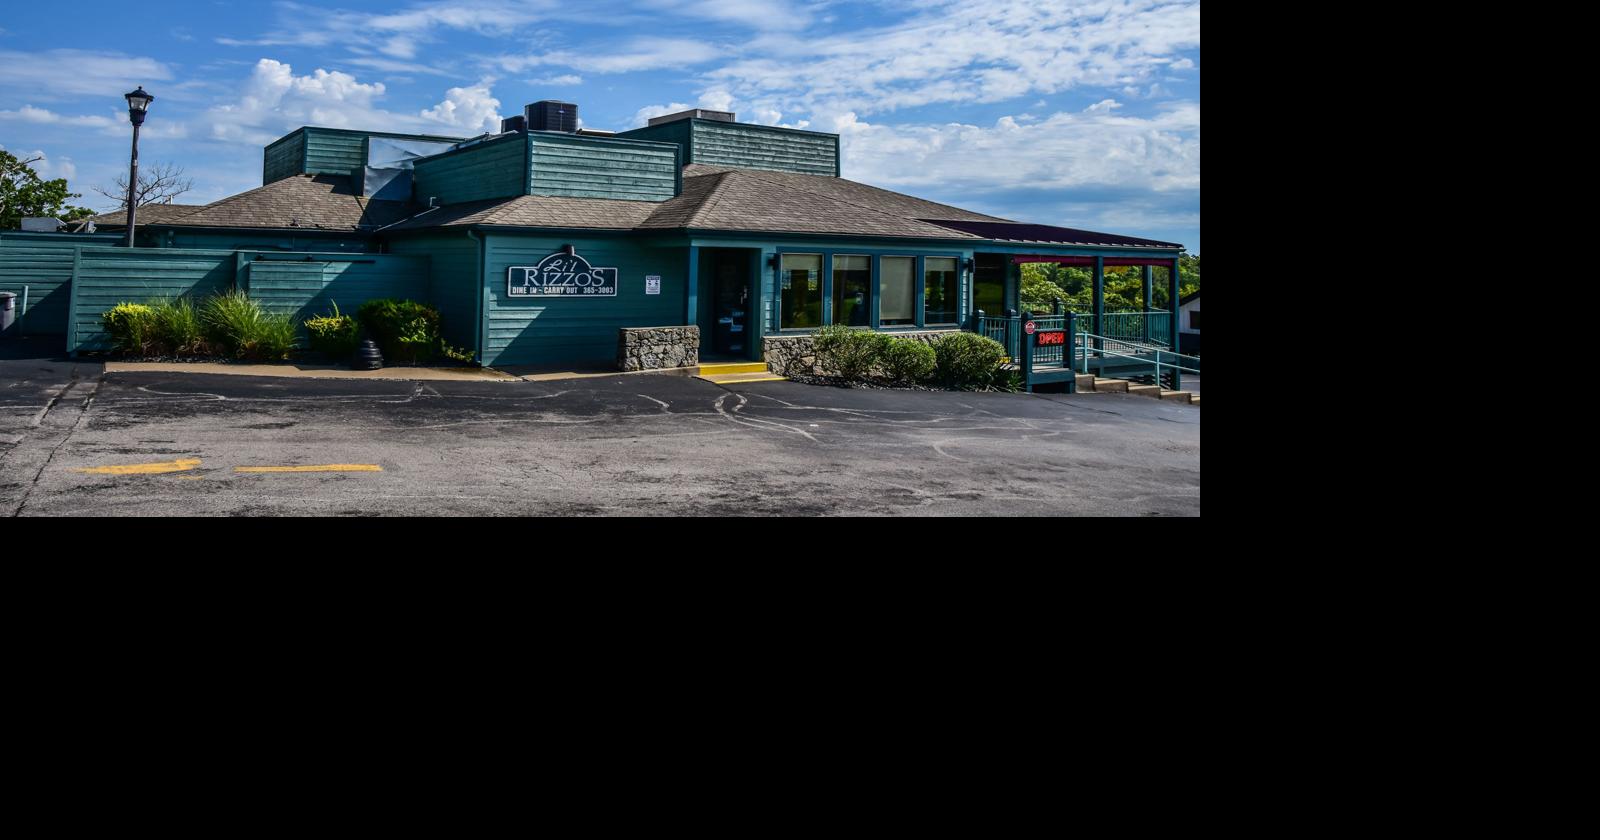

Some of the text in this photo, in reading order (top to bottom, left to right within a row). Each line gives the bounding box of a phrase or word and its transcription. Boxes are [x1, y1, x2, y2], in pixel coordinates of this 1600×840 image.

[543, 259, 577, 272] Li'l
[512, 286, 527, 294] DINE
[529, 286, 537, 294] IN
[543, 286, 565, 294] CARRY
[566, 286, 578, 294] OUT
[583, 286, 614, 294] 365-3003
[1039, 332, 1064, 344] OPEN
